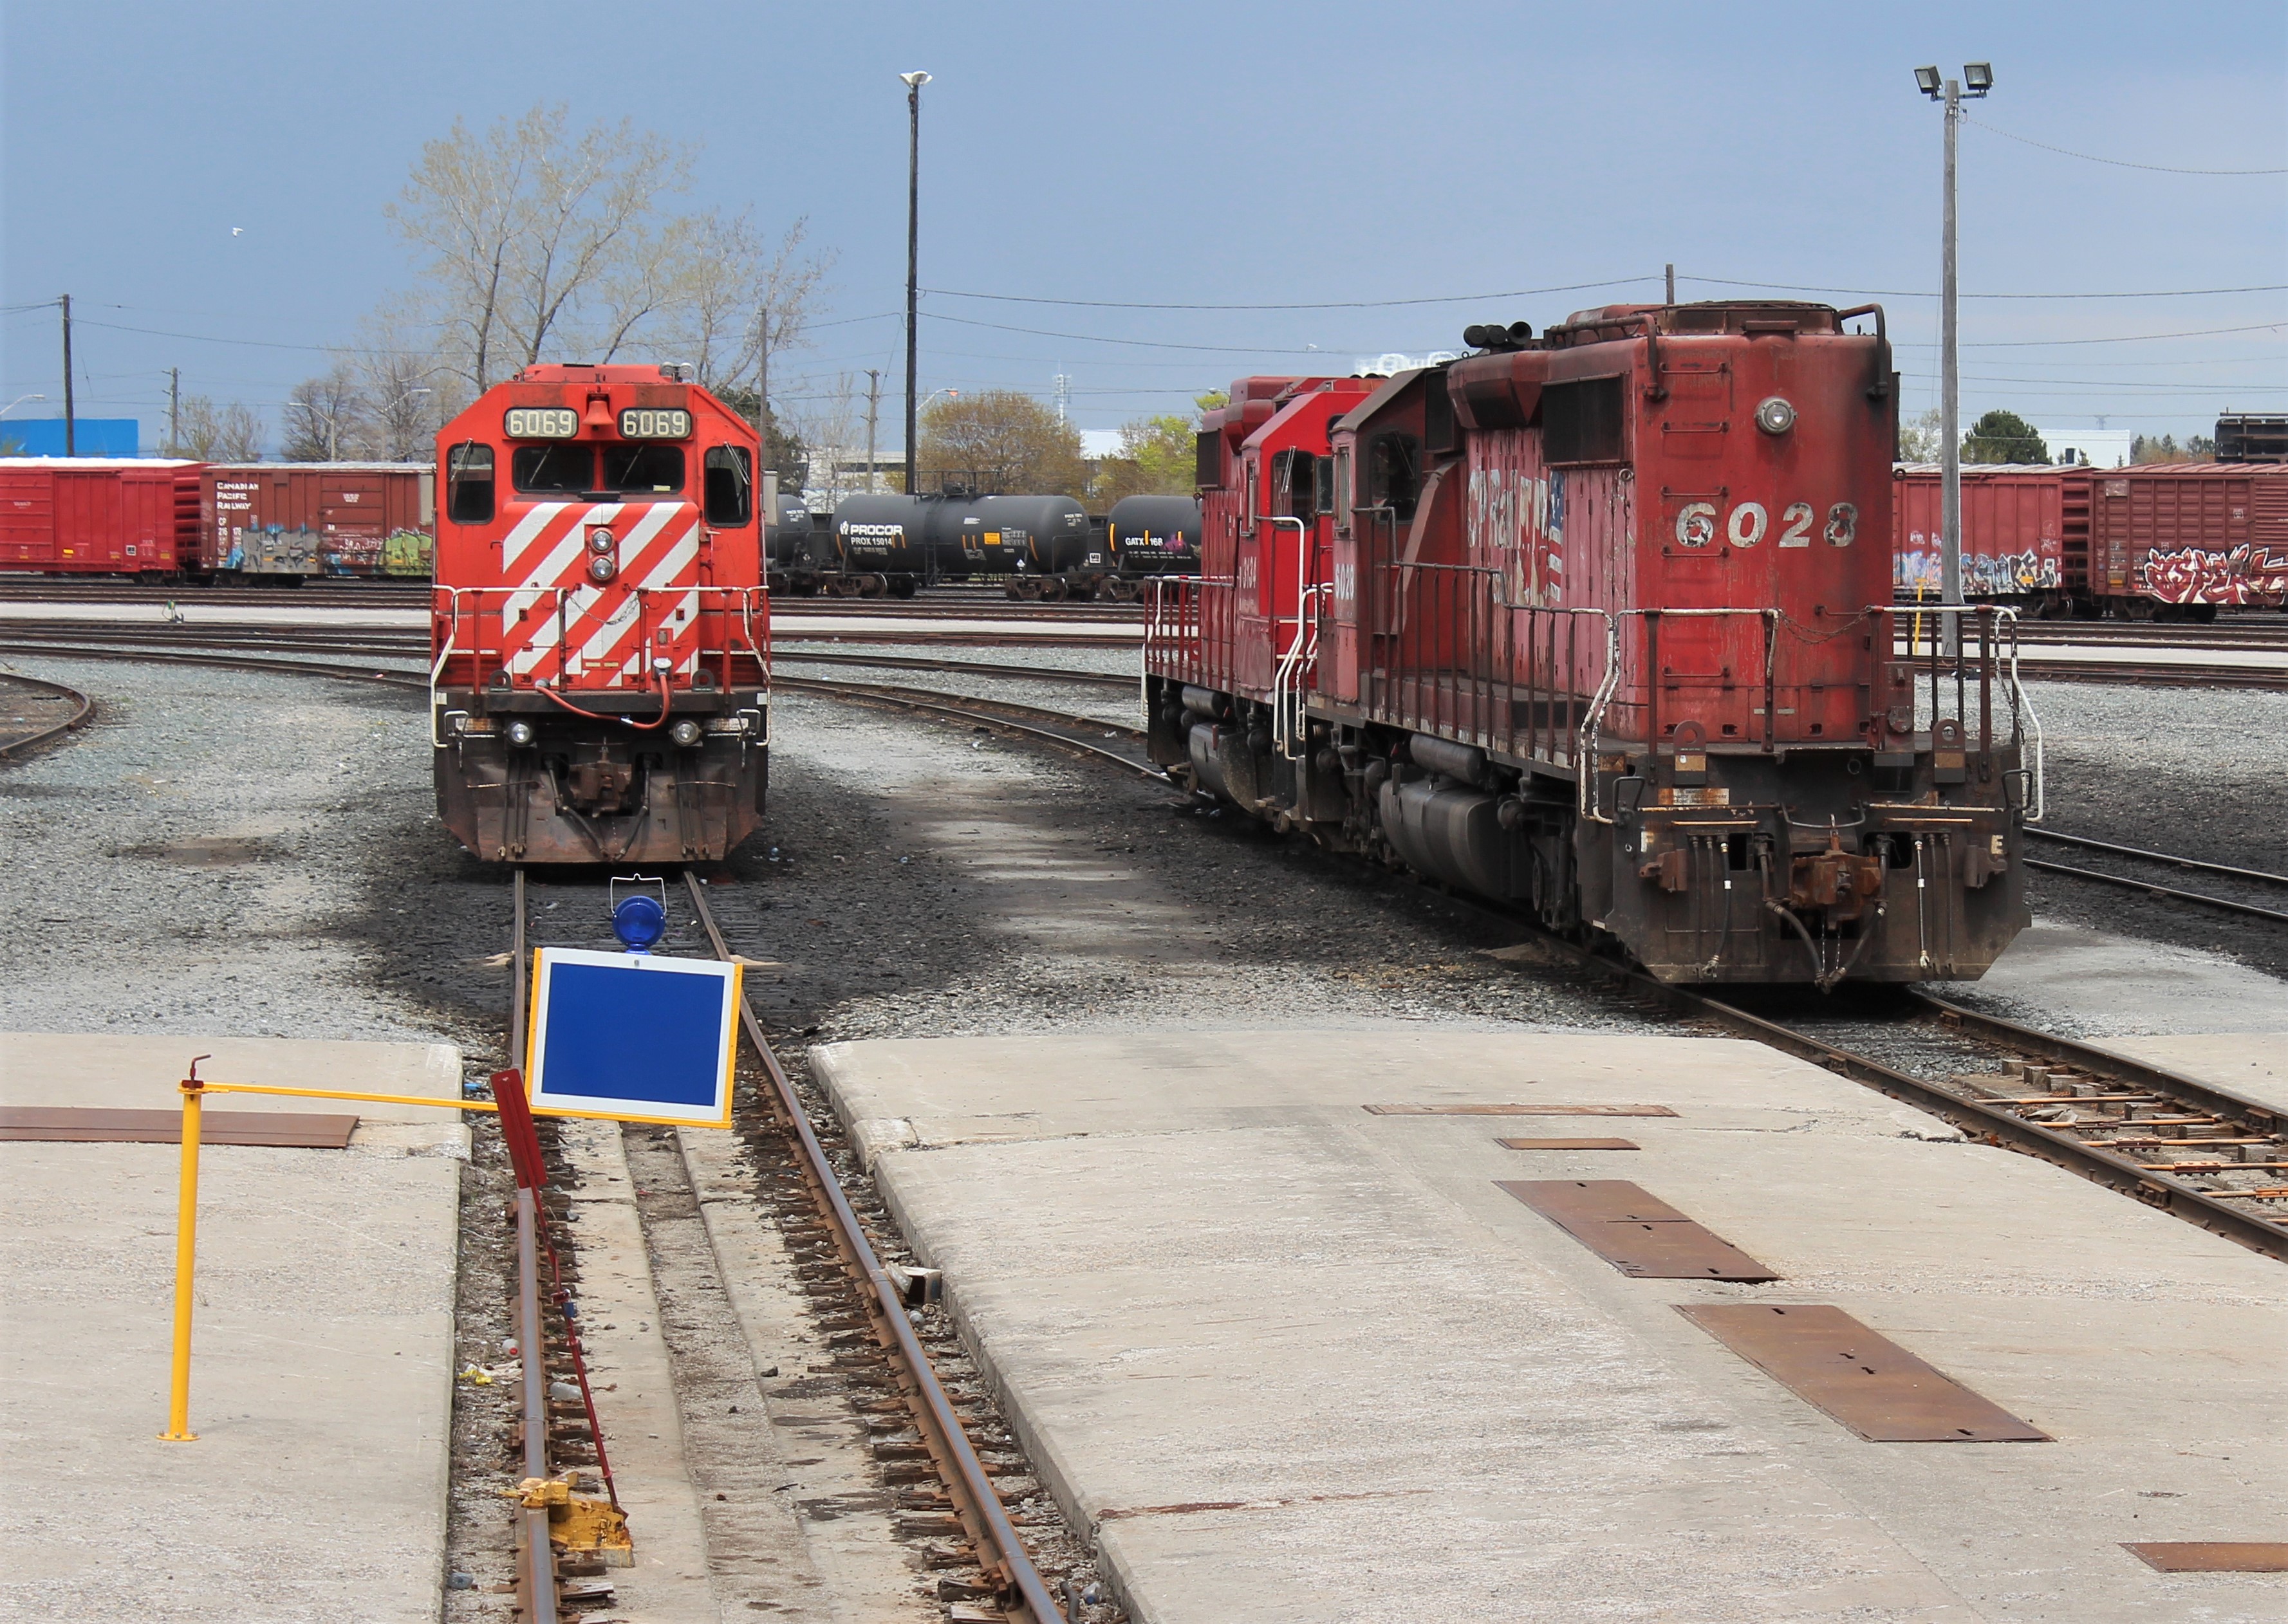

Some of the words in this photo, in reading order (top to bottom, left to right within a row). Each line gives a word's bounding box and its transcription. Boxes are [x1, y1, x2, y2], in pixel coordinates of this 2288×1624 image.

[510, 411, 573, 435] 6069
[623, 411, 685, 436] 6069
[217, 482, 259, 490] CANADIAN
[217, 502, 252, 510] RAILWAY
[850, 524, 904, 535] PROCOR
[1675, 502, 1859, 548] 6028
[850, 537, 871, 546] PROX
[871, 537, 893, 546] 15014
[1124, 537, 1145, 546] GATX
[1335, 563, 1354, 600] 6028
[1991, 835, 2004, 854] E
